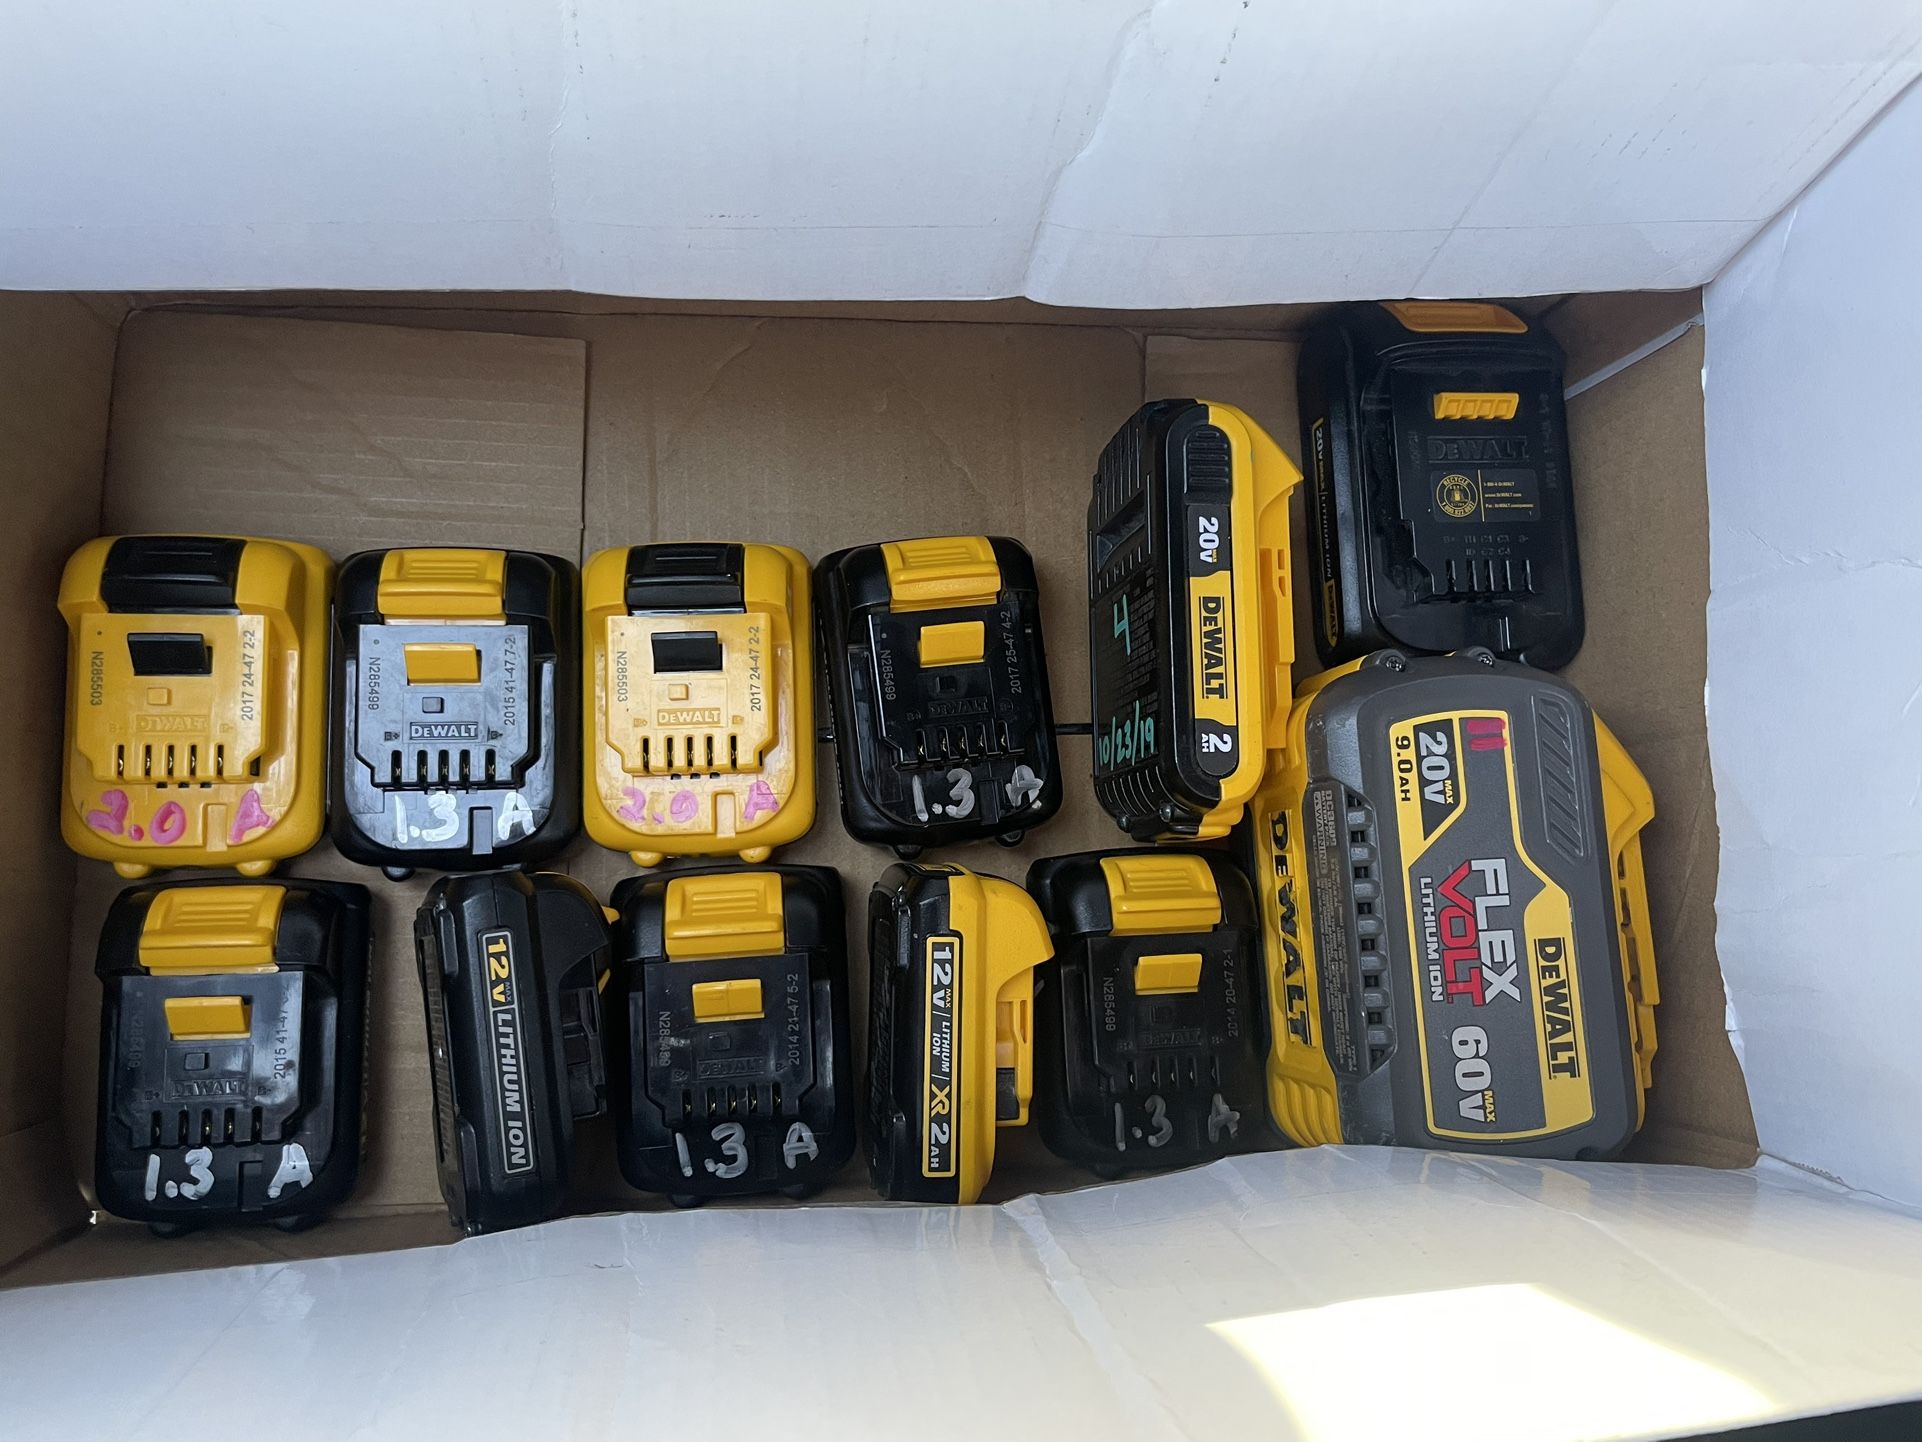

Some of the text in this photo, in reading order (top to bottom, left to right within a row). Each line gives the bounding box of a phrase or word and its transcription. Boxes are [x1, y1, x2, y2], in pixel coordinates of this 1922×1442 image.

[1198, 516, 1219, 563] 20V
[1003, 610, 1022, 694] 2017 25-47 4-2
[1113, 595, 1131, 656] 4
[1202, 596, 1224, 699] DEWALT
[90, 651, 104, 706] N285503
[241, 629, 255, 721] 2017 24-47 2-2
[368, 657, 381, 710] N285499
[504, 637, 516, 726] 2015 41-47 7-2
[617, 651, 628, 702] N285503
[748, 626, 761, 712] 2017 24-47 2-2
[880, 650, 896, 701] N285499
[411, 724, 477, 737] DEWALT
[658, 711, 720, 723] DEWALT
[912, 767, 976, 822] 1.3
[1394, 735, 1412, 803] 9.0AH
[1418, 731, 1454, 805] 20V MAX
[87, 788, 275, 844] 2.0 A
[394, 791, 536, 843] 1.3 A
[616, 780, 780, 825] 2.0 A
[1315, 808, 1328, 874] WARNING
[1420, 877, 1444, 1002] LITHIUM ION
[1437, 860, 1485, 1007] VOLT
[1471, 858, 1521, 1004] FLEX
[488, 938, 513, 1003] 12V MAX
[931, 946, 952, 1008] 12V
[1223, 949, 1239, 1037] 2014 20-47 2-1
[787, 973, 799, 1066] 2014 21-47 5-2
[1104, 977, 1117, 1031] N285499
[1537, 938, 1579, 1079] DEWALT
[273, 1048, 286, 1079] 2015
[932, 1032, 941, 1056] ION
[941, 1022, 950, 1073] LITHIUM
[1450, 1025, 1496, 1123] 60V MAX
[497, 1012, 527, 1165] LITHIUM ION
[930, 1084, 950, 1118] XR
[675, 1121, 819, 1179] 1.3 A
[1114, 1093, 1240, 1151] 1.3 A
[145, 1142, 314, 1201] 1.3 A
